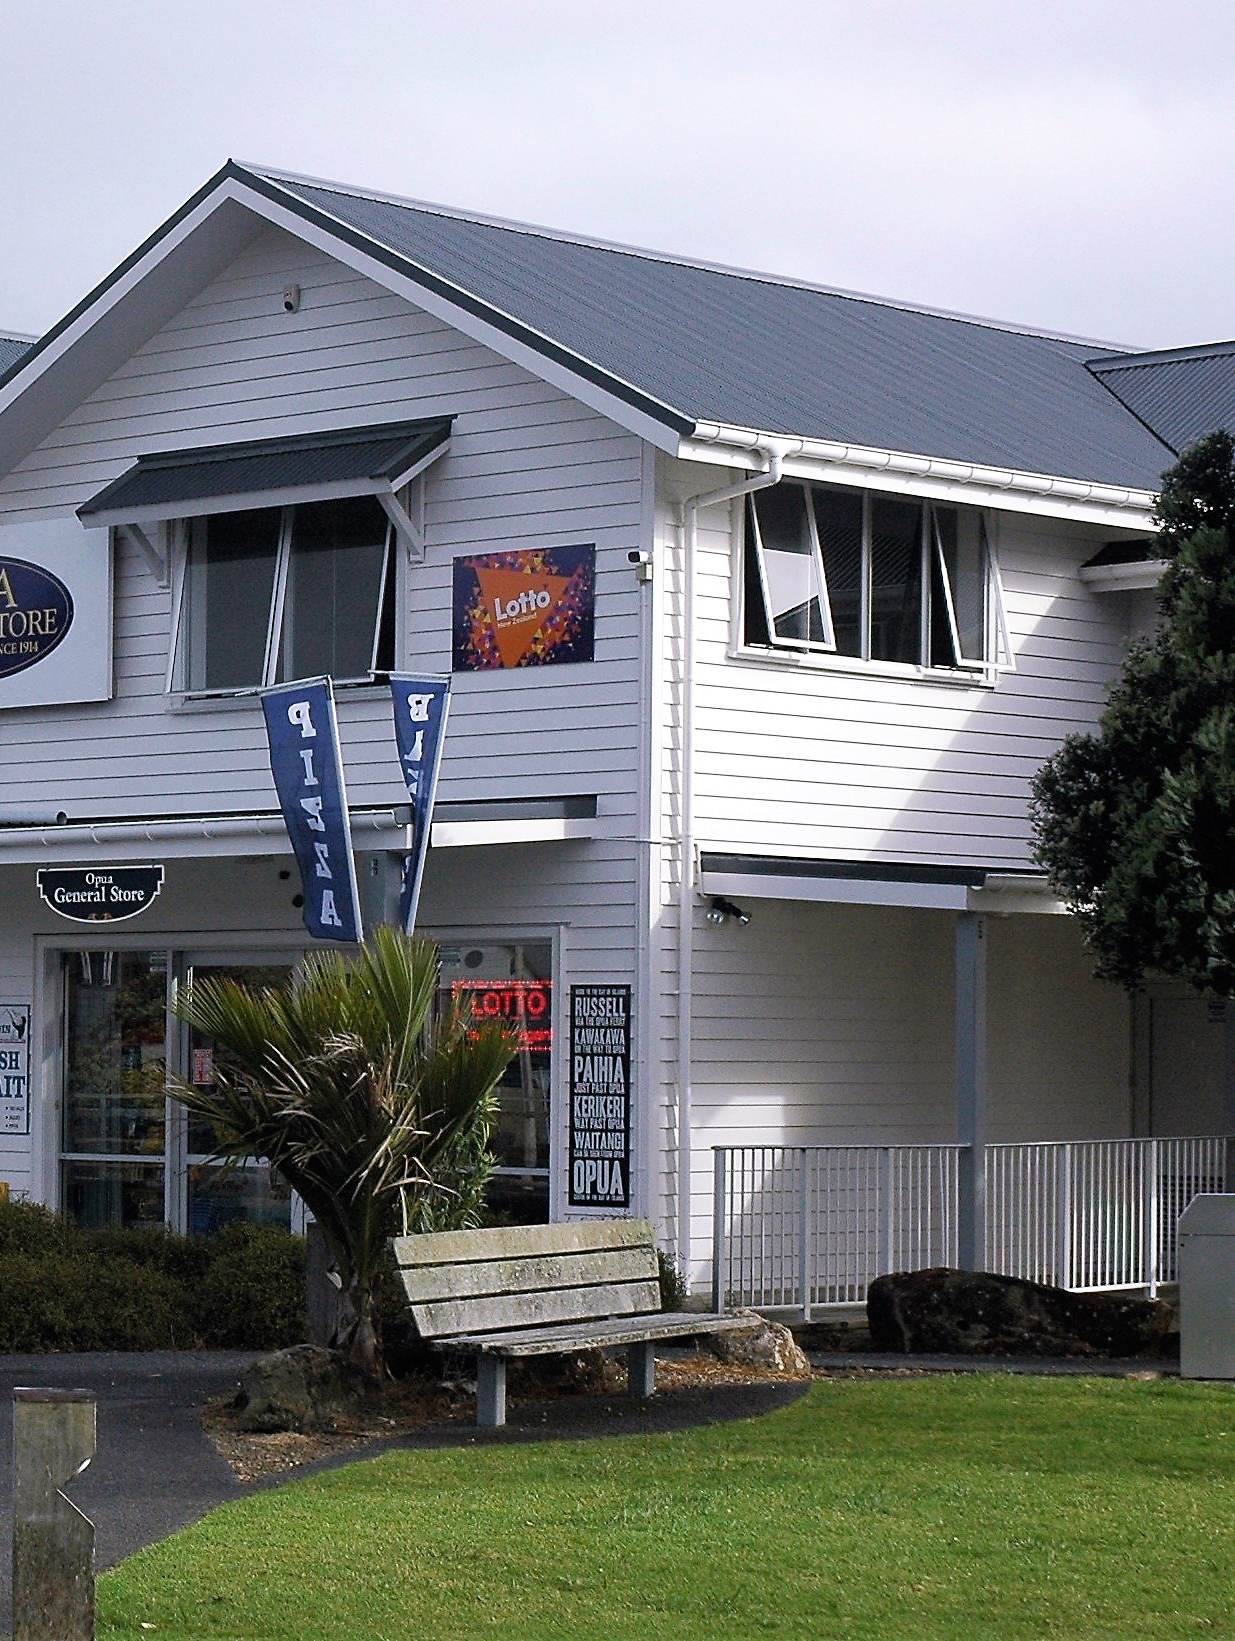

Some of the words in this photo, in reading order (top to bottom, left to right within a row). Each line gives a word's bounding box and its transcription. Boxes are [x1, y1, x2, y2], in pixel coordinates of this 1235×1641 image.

[494, 589, 551, 621] Lotto
[19, 641, 39, 654] 1914
[85, 873, 113, 889] Opua
[54, 886, 106, 903] General
[110, 886, 145, 902] Store
[470, 990, 547, 1015] LOTTO
[575, 997, 625, 1017] RUSSELL
[574, 1028, 625, 1045] KAWAKAWA
[574, 1055, 625, 1083] PAIHIA
[574, 1083, 590, 1094] JUST
[591, 1083, 607, 1094] PAST
[574, 1095, 625, 1118] KERIKERI
[574, 1131, 625, 1150] WAITANGI
[573, 1159, 624, 1195] OPUA
